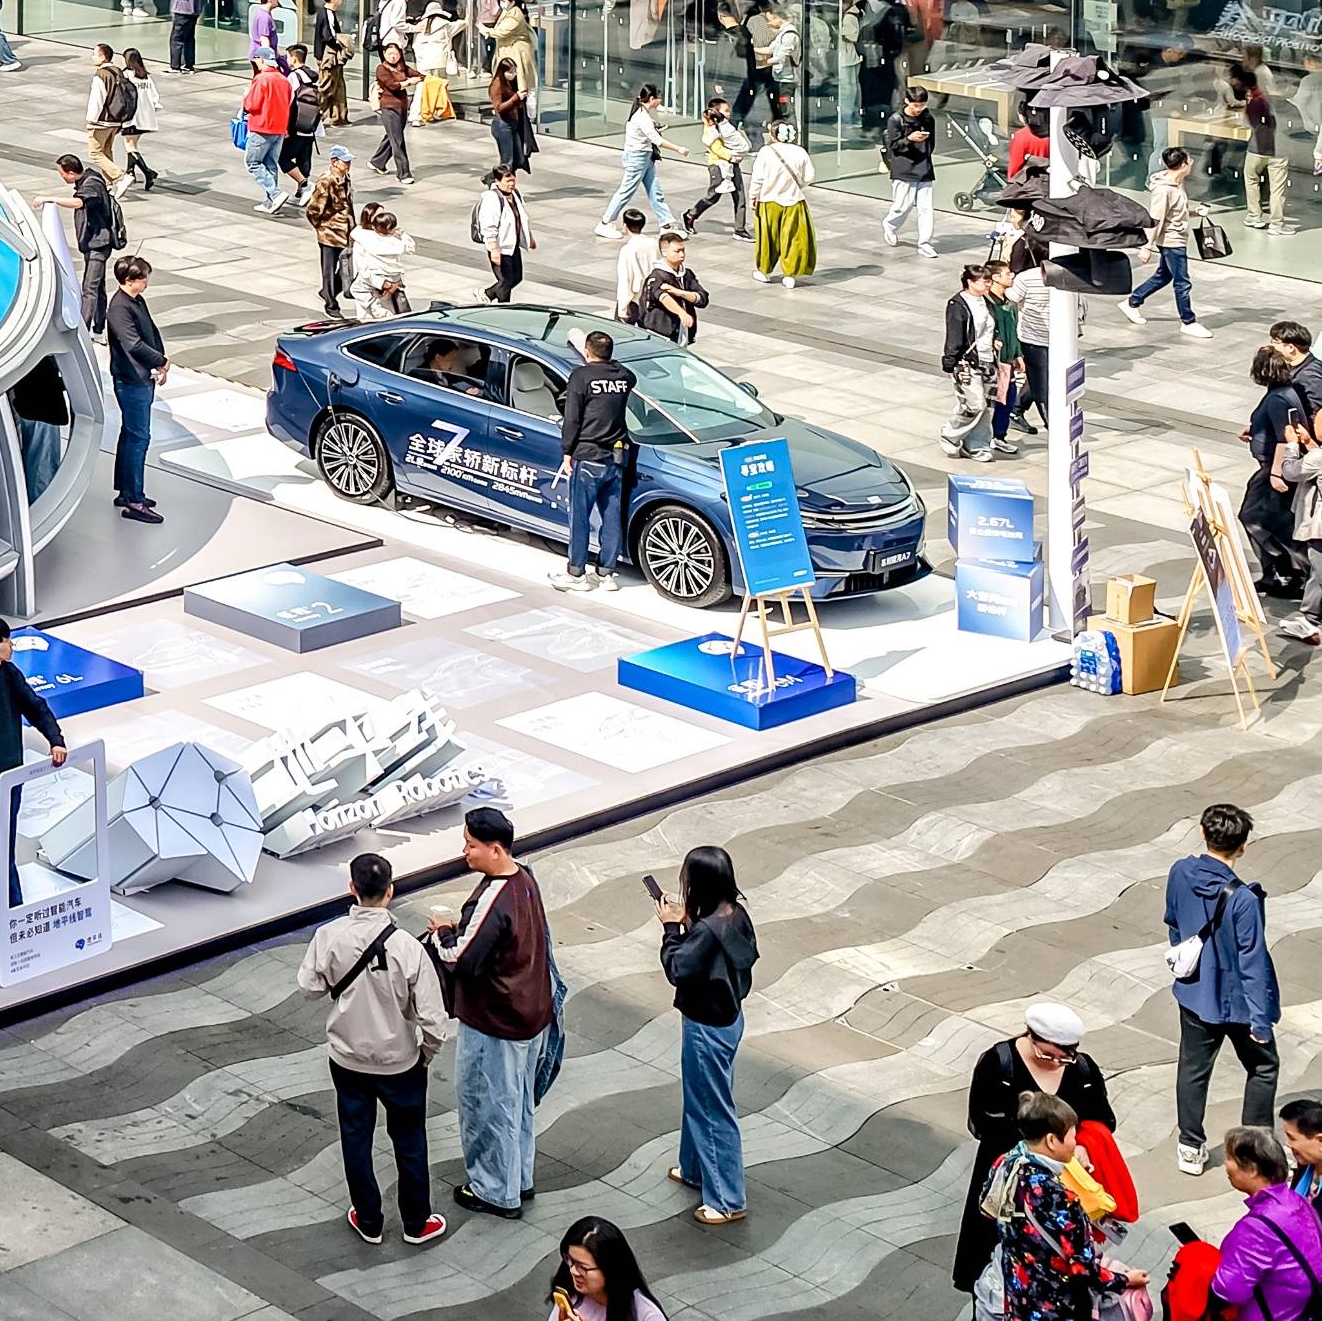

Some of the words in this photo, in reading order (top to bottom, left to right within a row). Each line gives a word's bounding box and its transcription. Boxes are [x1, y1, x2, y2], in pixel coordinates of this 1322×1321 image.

[590, 379, 628, 394] STAFF
[430, 419, 471, 466] 7
[9, 896, 82, 929] 你一定听过智能汽车
[9, 921, 51, 944] 但未必知道
